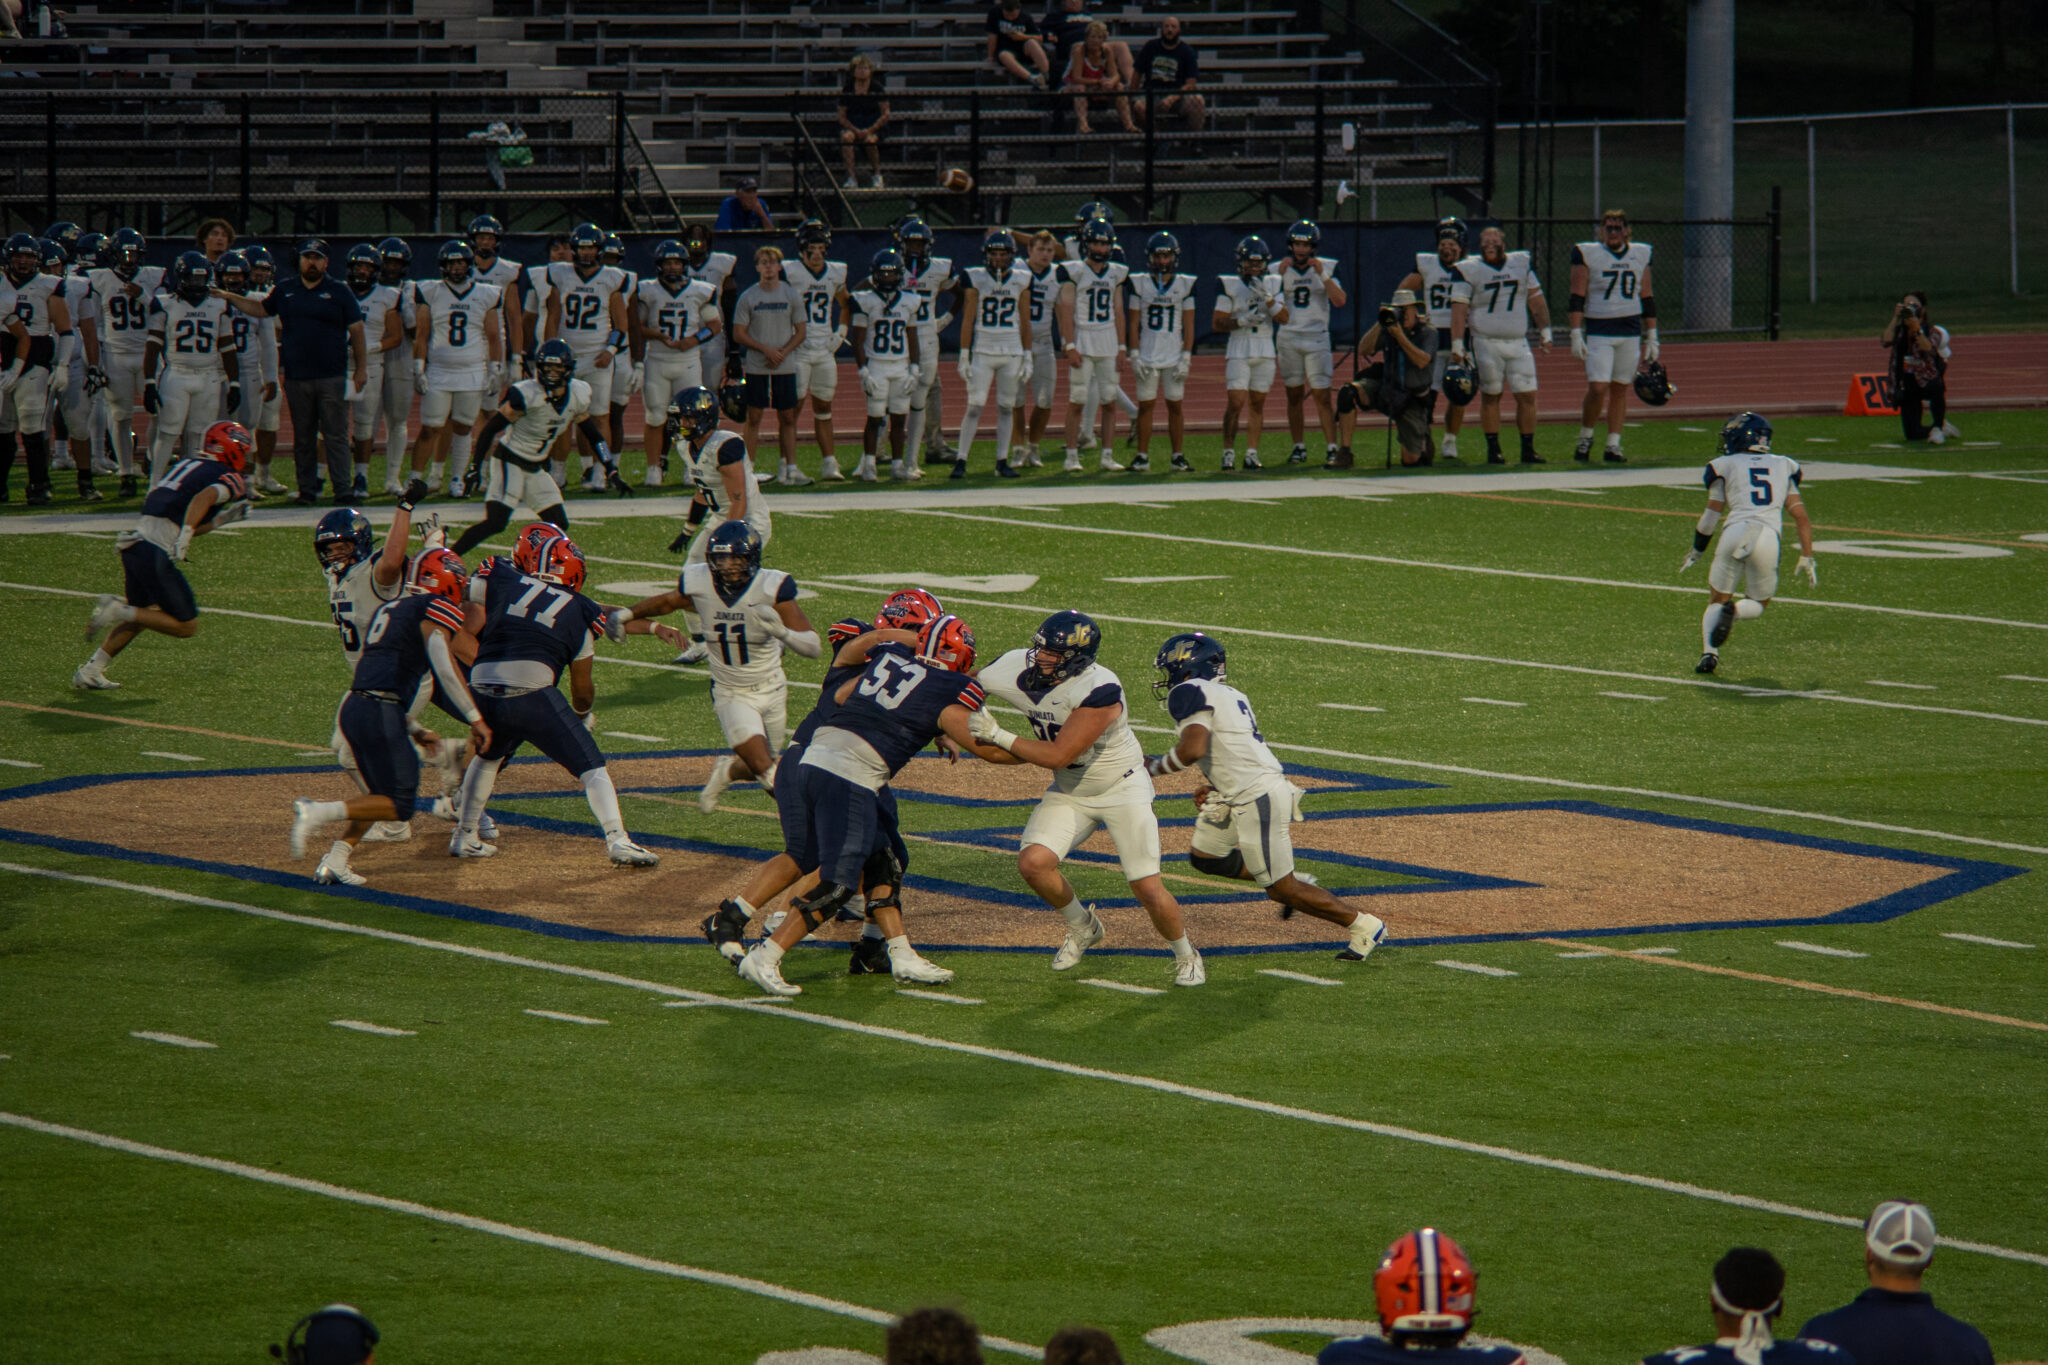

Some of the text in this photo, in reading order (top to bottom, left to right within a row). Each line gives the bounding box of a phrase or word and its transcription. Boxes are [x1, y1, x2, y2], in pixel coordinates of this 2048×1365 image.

[1484, 280, 1518, 313] 77
[1602, 271, 1636, 300] 70
[109, 297, 146, 330] 99
[566, 294, 600, 330] 92
[803, 292, 829, 324] 13
[982, 297, 1015, 327] 82
[1085, 288, 1110, 322] 19
[1147, 305, 1175, 332] 81
[176, 320, 213, 353] 25
[449, 311, 467, 347] 8
[659, 310, 688, 341] 51
[873, 320, 905, 354] 89
[156, 459, 204, 491] 11
[1749, 468, 1773, 506] 5
[506, 576, 574, 629] 77
[365, 602, 400, 645] 6
[714, 623, 749, 665] 11
[859, 652, 927, 710] 53
[1028, 709, 1056, 722] JUNIATA
